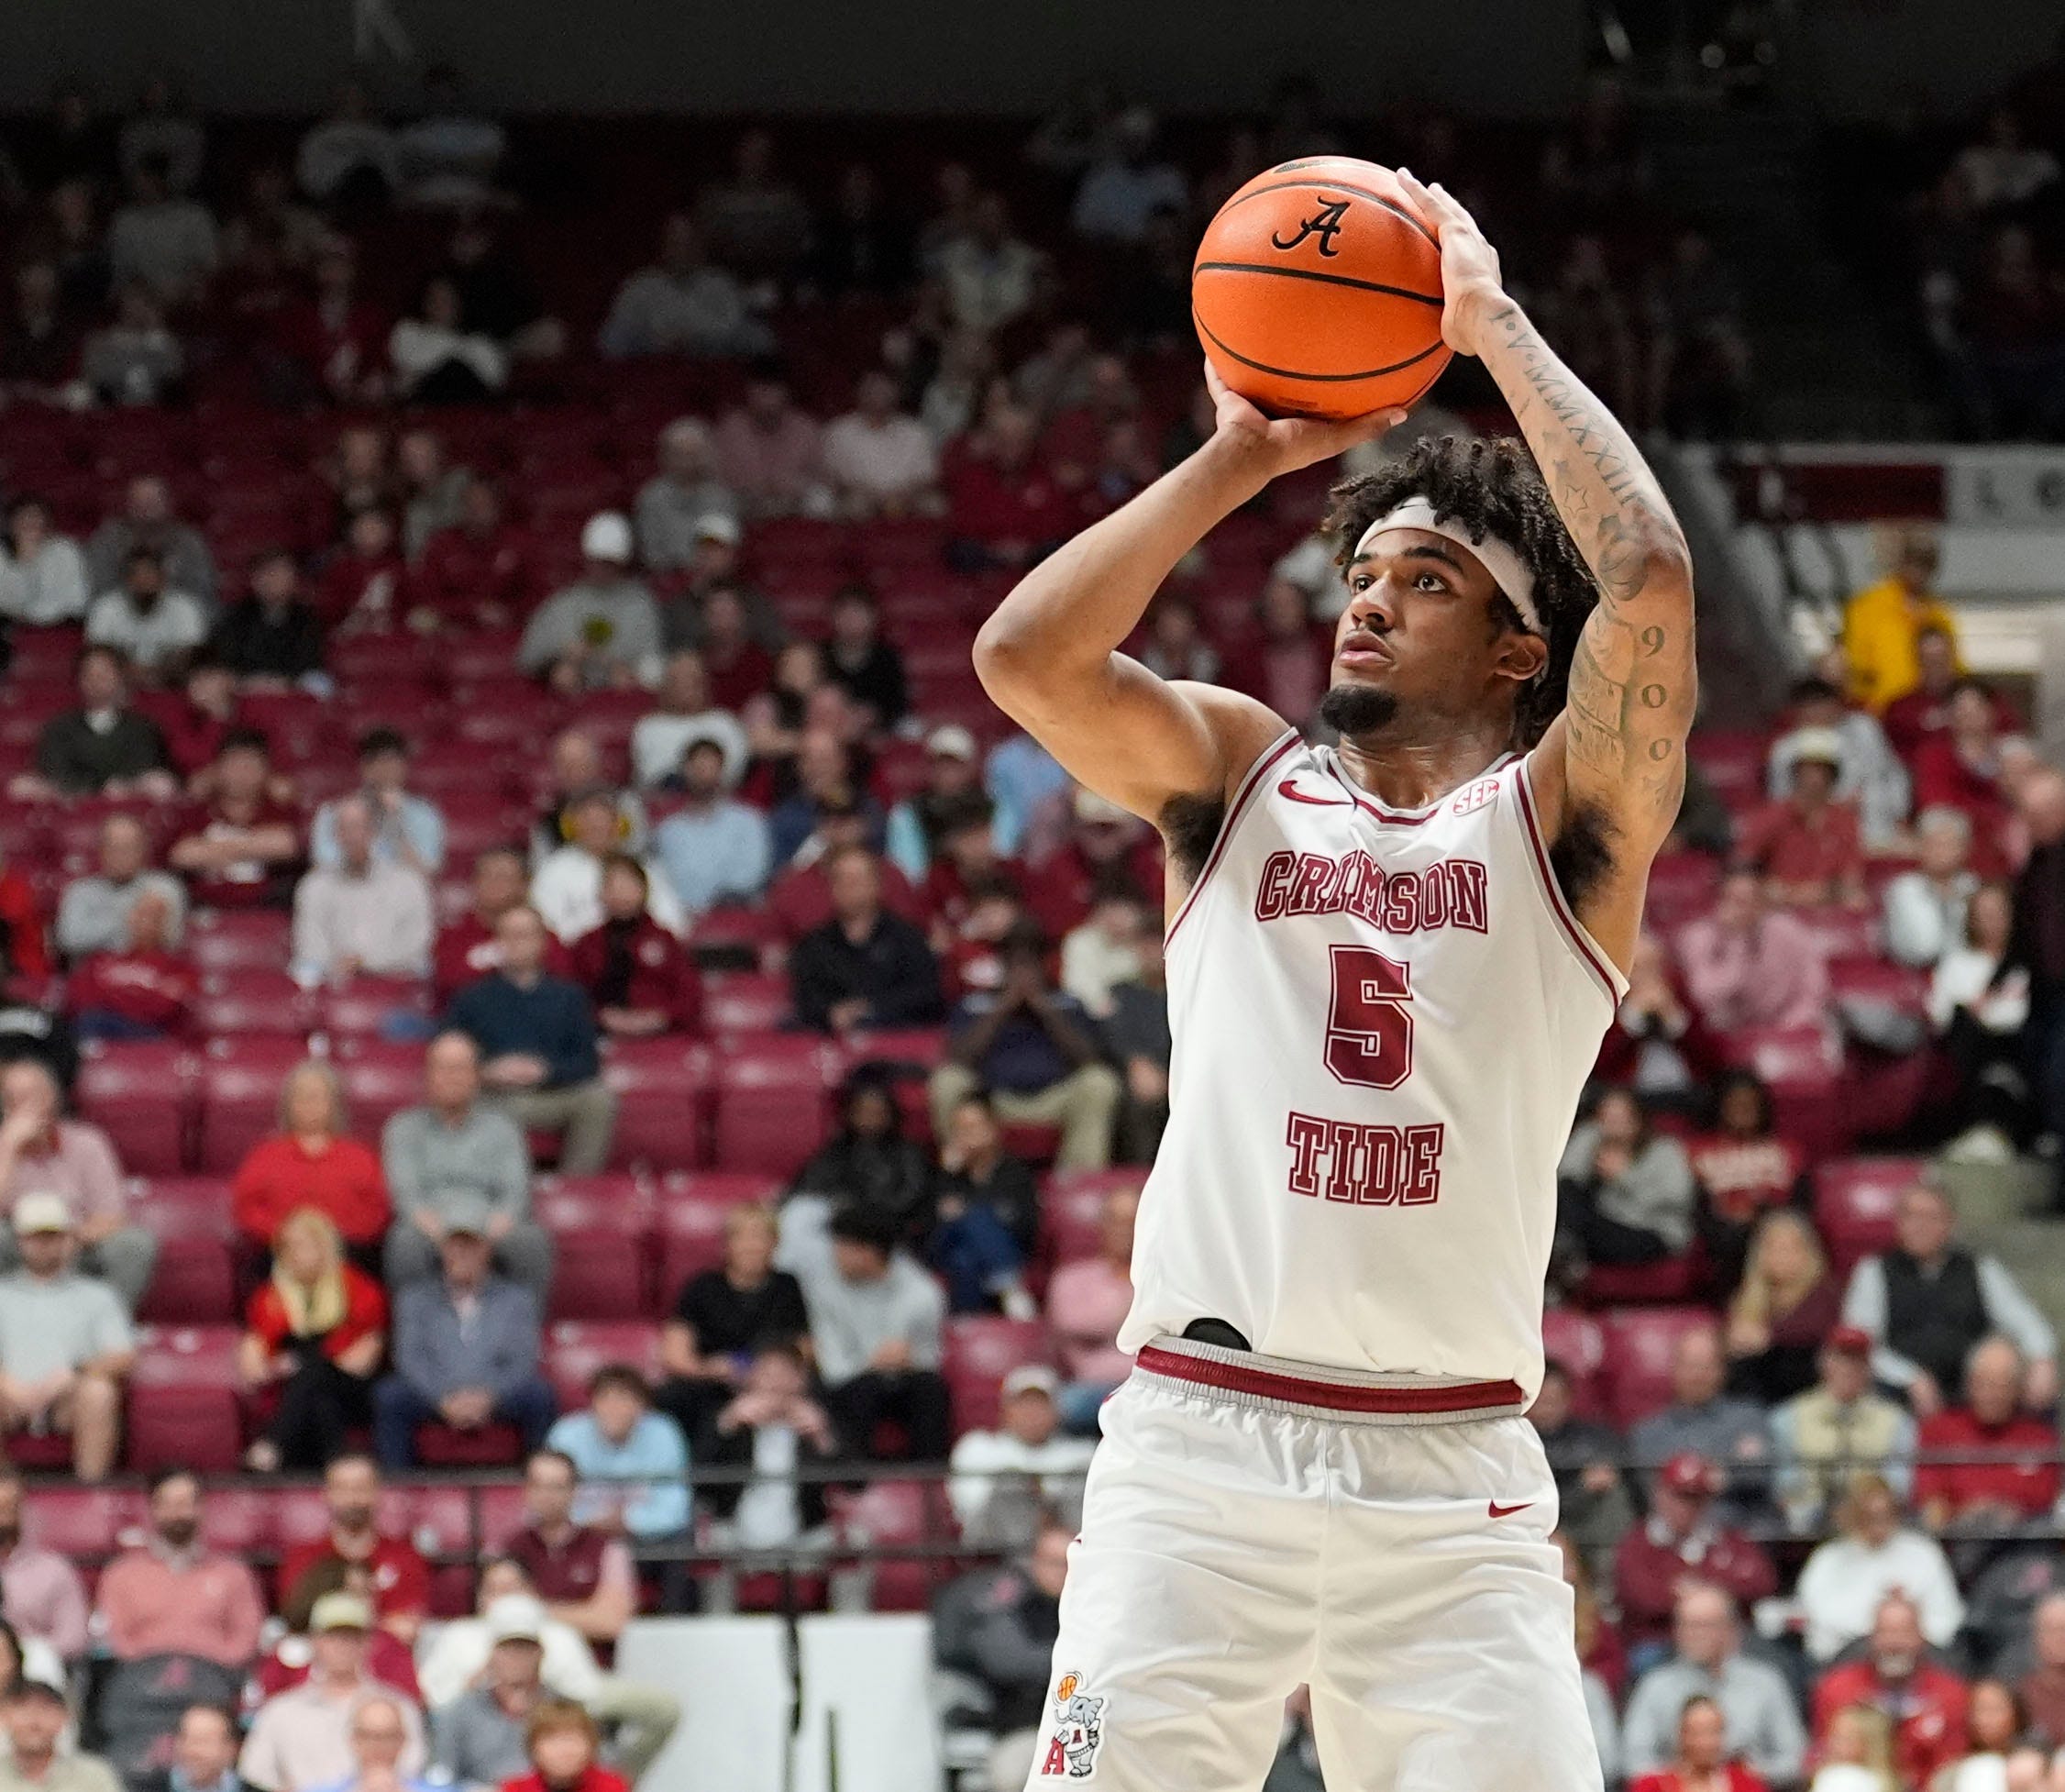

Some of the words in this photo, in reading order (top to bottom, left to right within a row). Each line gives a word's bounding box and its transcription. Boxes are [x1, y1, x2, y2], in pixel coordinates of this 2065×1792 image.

[1272, 195, 1351, 257] A
[1453, 780, 1499, 814] SEC
[1255, 849, 1488, 935] CRIMSON
[1323, 944, 1413, 1090] 5
[1286, 1111, 1444, 1207] TIDE
[1041, 1736, 1066, 1775] A
